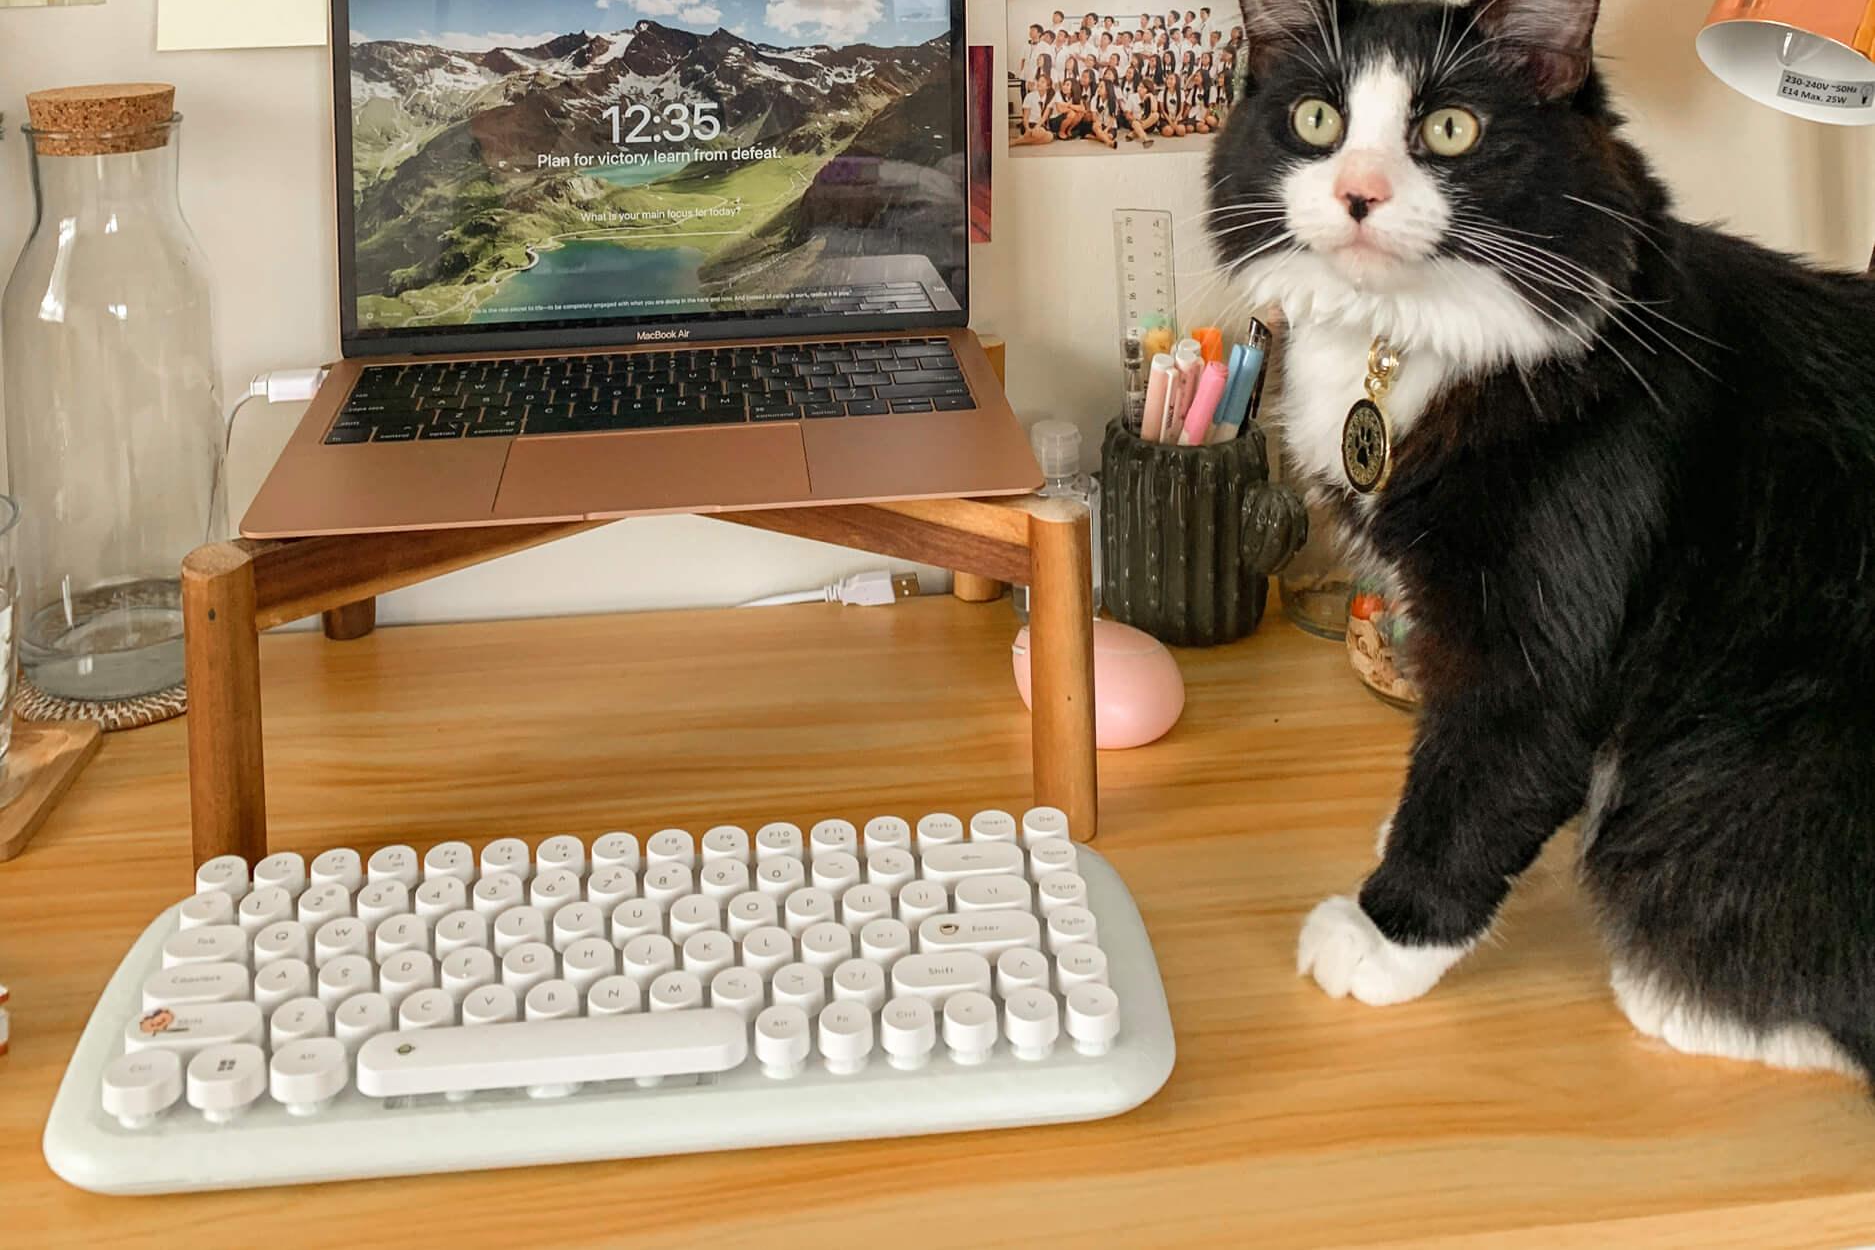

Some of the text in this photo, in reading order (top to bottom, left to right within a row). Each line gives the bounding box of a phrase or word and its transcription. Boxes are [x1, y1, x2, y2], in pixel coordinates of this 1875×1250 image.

[1785, 75, 1830, 91] 230-240V
[1782, 86, 1847, 104] E14 Max. 25W
[601, 102, 721, 144] 12:35
[537, 146, 782, 168] Plan for victory, learn from defeat.
[581, 206, 742, 224] What is your main focus for today?
[636, 329, 690, 341] MacBook Air
[275, 928, 351, 941] Q W
